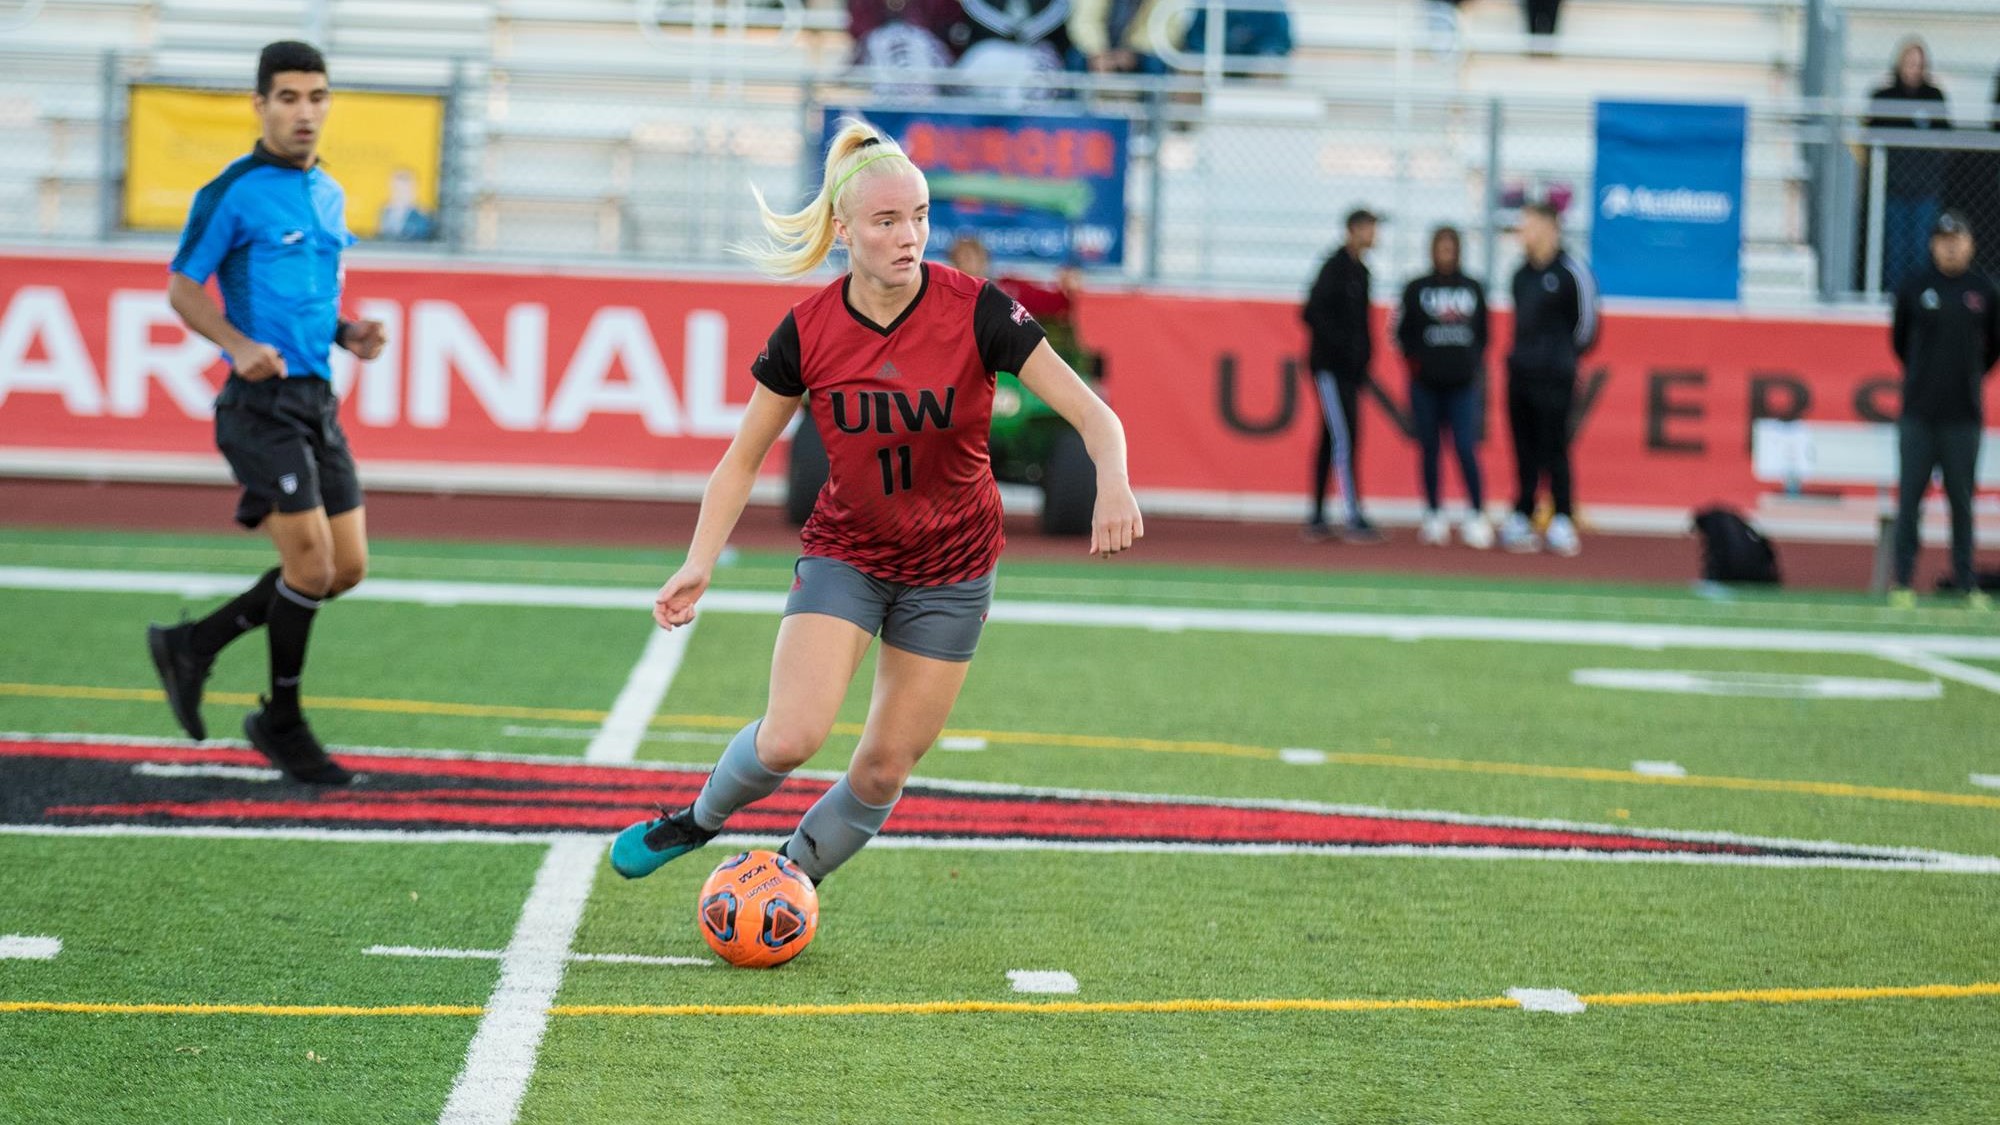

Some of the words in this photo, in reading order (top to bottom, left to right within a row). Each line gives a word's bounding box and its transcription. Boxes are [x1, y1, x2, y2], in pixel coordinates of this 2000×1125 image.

[0, 284, 803, 440] ARINAL
[828, 386, 955, 434] UIW
[877, 445, 912, 495] 11
